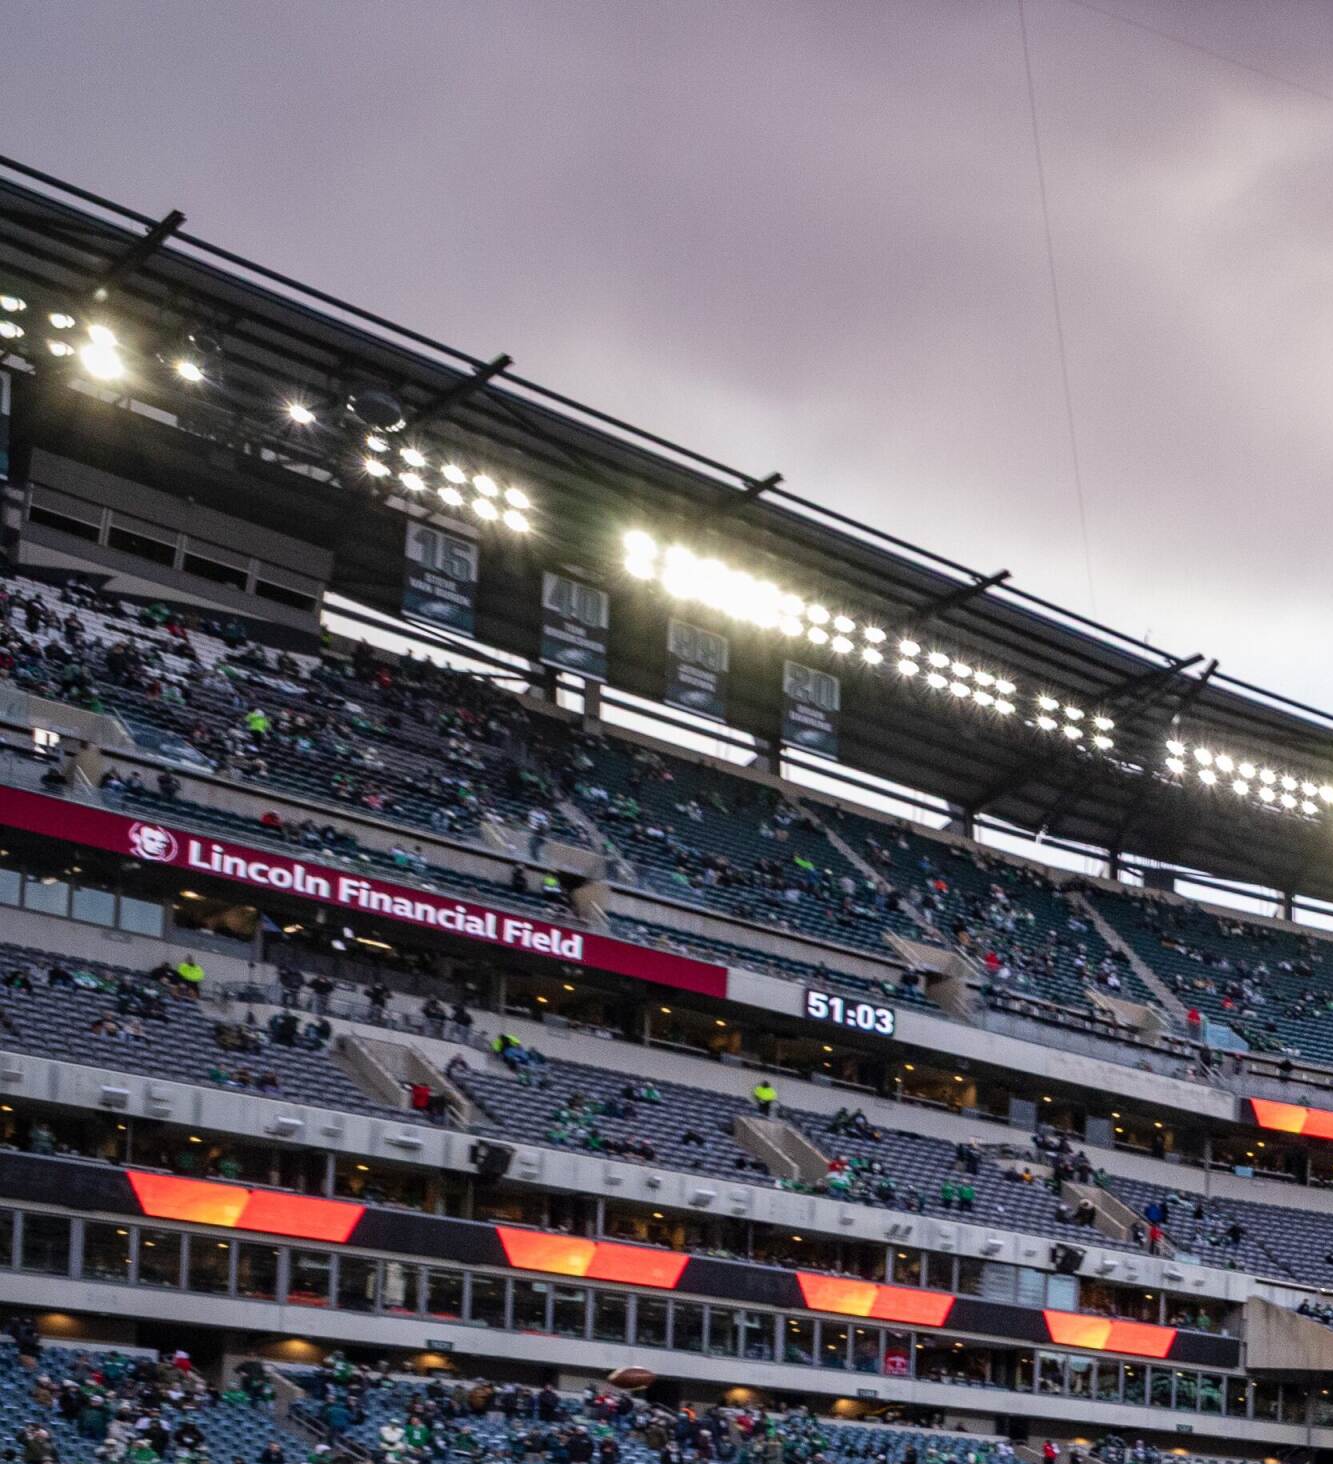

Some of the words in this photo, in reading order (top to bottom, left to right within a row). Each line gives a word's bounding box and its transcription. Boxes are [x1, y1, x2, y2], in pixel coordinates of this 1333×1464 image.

[188, 838, 331, 899] Lincoln
[338, 875, 498, 940] Financial
[502, 918, 584, 961] Field
[807, 990, 895, 1035] 51:03
